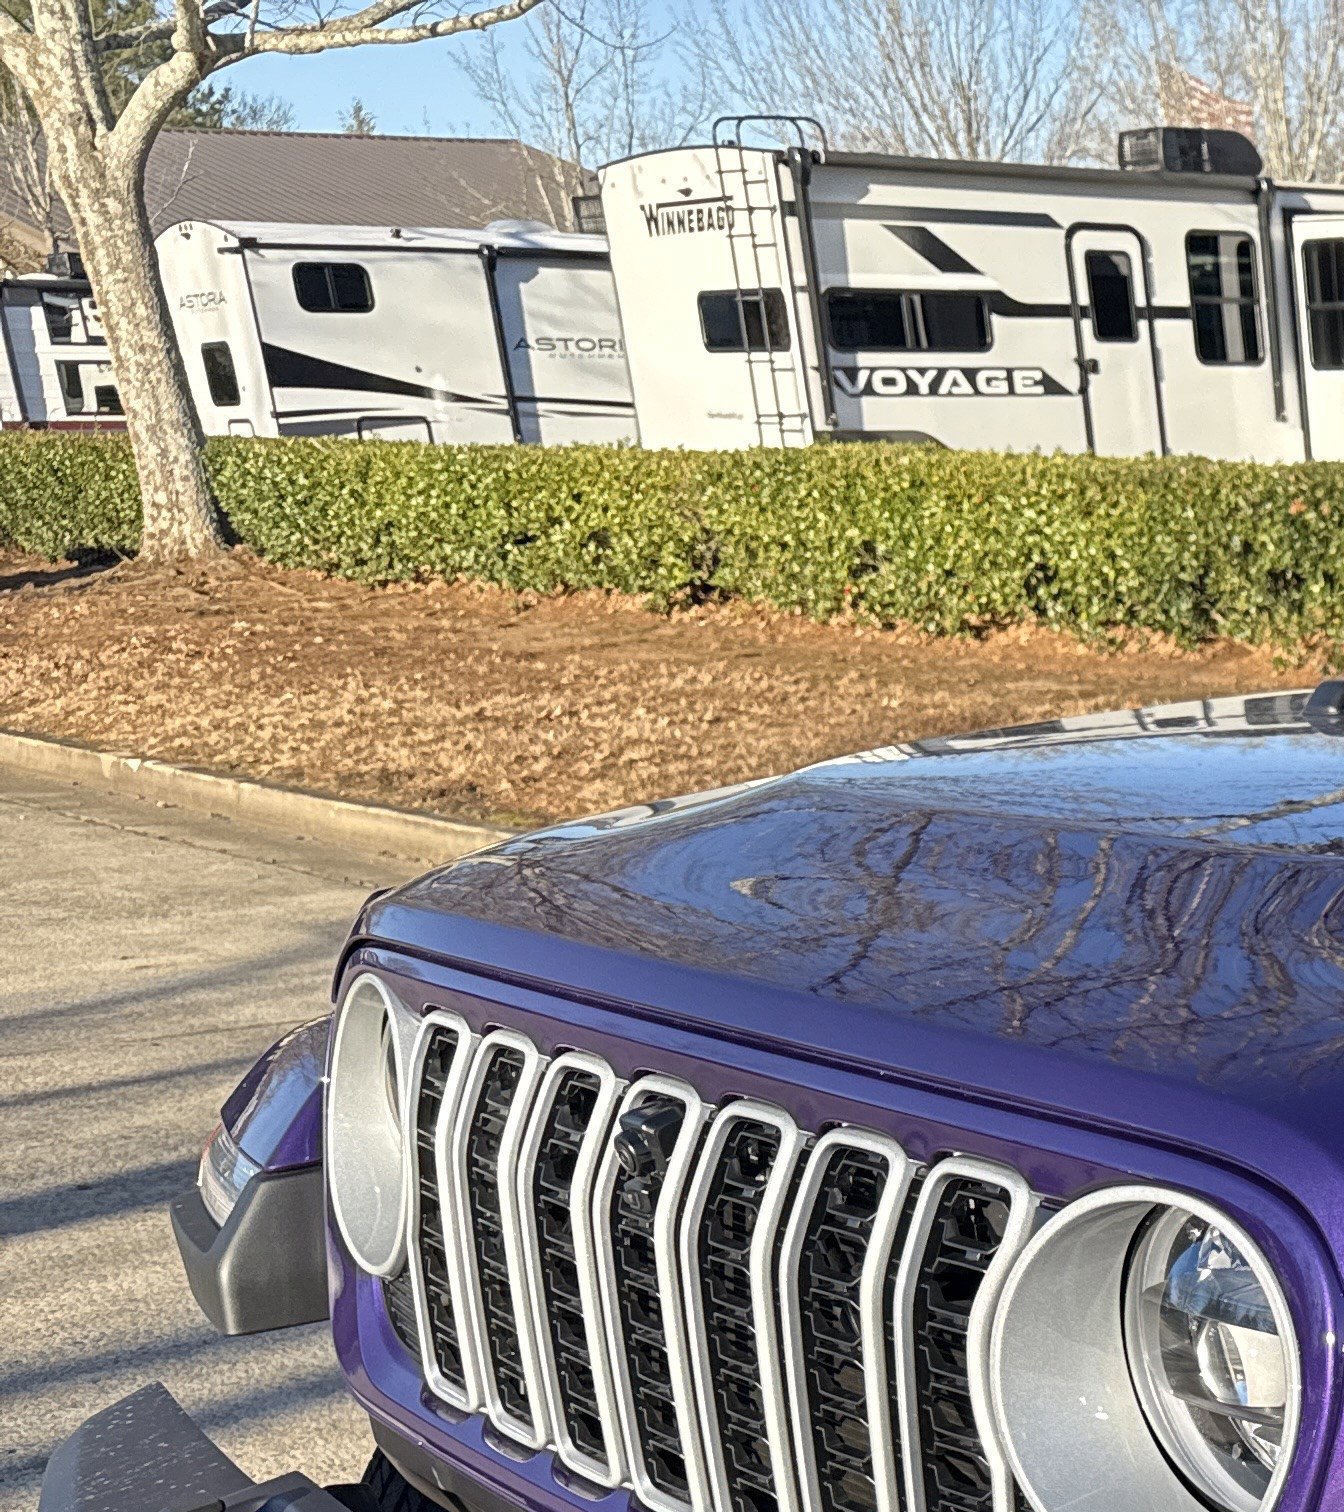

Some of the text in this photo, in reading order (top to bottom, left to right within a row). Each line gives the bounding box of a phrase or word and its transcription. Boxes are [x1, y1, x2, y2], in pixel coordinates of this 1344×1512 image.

[640, 197, 734, 237] WINNEBAGO
[513, 337, 624, 352] ASTORI
[834, 368, 1045, 395] VOYAGE
